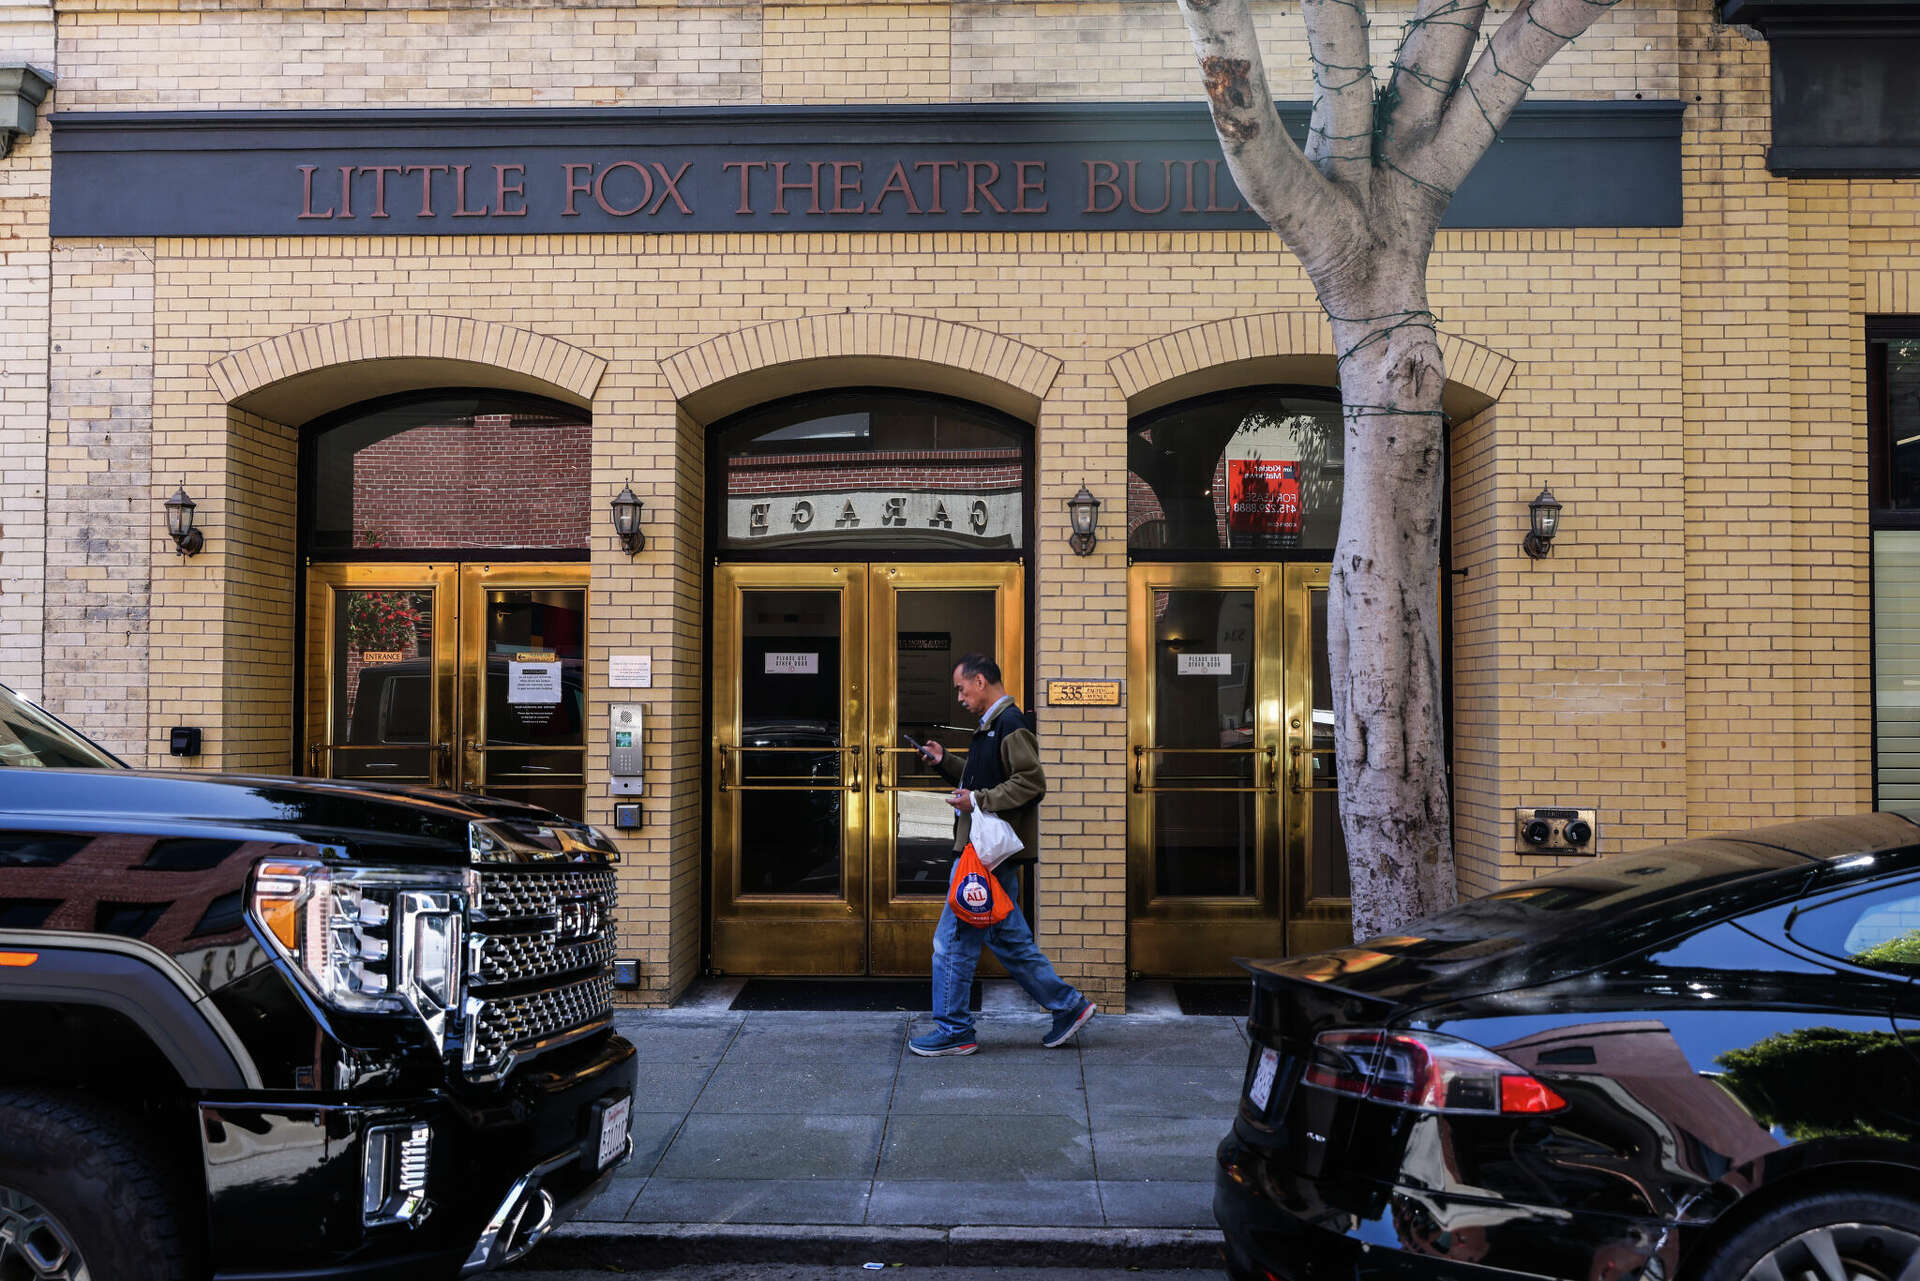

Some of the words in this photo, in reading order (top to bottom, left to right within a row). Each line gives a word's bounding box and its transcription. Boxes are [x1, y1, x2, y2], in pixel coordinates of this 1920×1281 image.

[297, 163, 528, 219] LITTLE
[560, 160, 694, 217] FOX
[723, 160, 1049, 215] THEATRE
[1081, 160, 1258, 215] BUIL
[1060, 686, 1083, 701] 535
[967, 891, 985, 902] ALL
